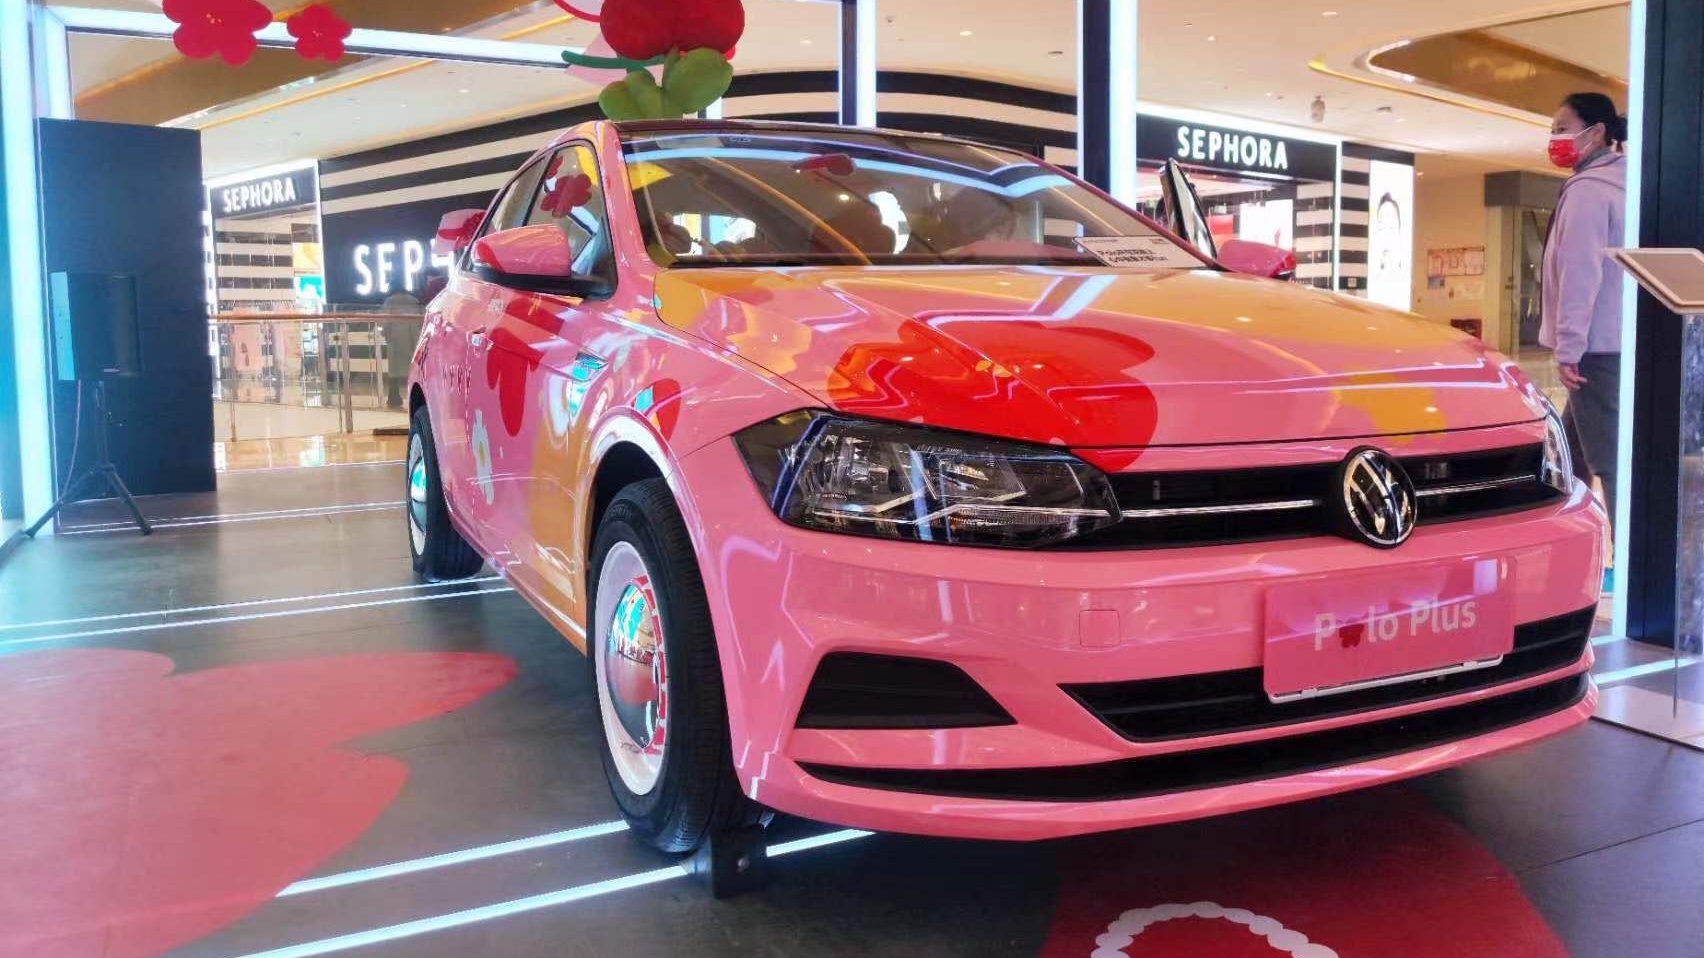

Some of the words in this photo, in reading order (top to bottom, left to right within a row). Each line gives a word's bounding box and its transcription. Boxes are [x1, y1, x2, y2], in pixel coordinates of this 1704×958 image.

[1177, 126, 1288, 169] SEPHORA
[223, 177, 296, 213] SEPHORA
[1314, 604, 1398, 651] Plo
[1410, 594, 1476, 636] Plus
